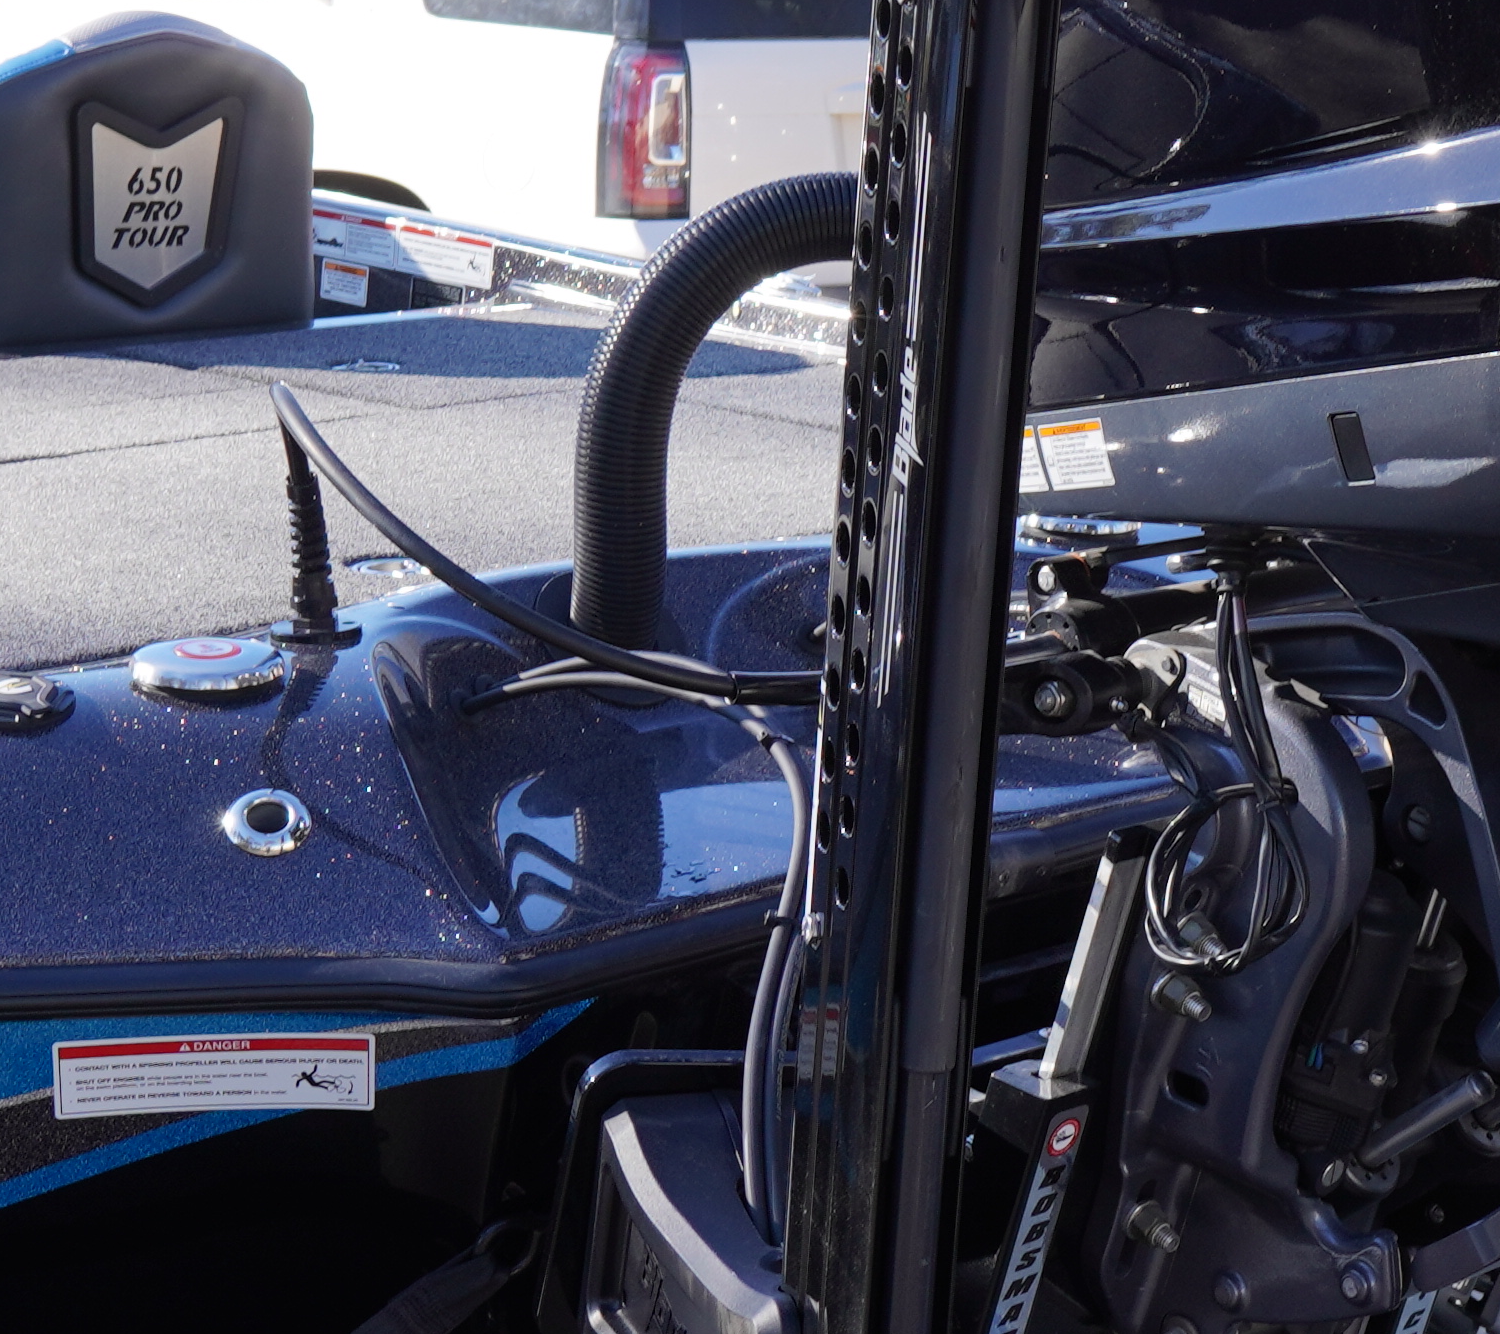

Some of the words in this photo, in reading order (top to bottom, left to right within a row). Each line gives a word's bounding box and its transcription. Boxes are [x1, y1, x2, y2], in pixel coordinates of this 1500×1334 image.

[127, 166, 183, 196] 650
[122, 200, 183, 224] PRO
[111, 225, 190, 250] TOUR
[891, 345, 924, 489] Blade
[193, 1040, 250, 1052] DANGER
[175, 1058, 218, 1067] PROPELLER
